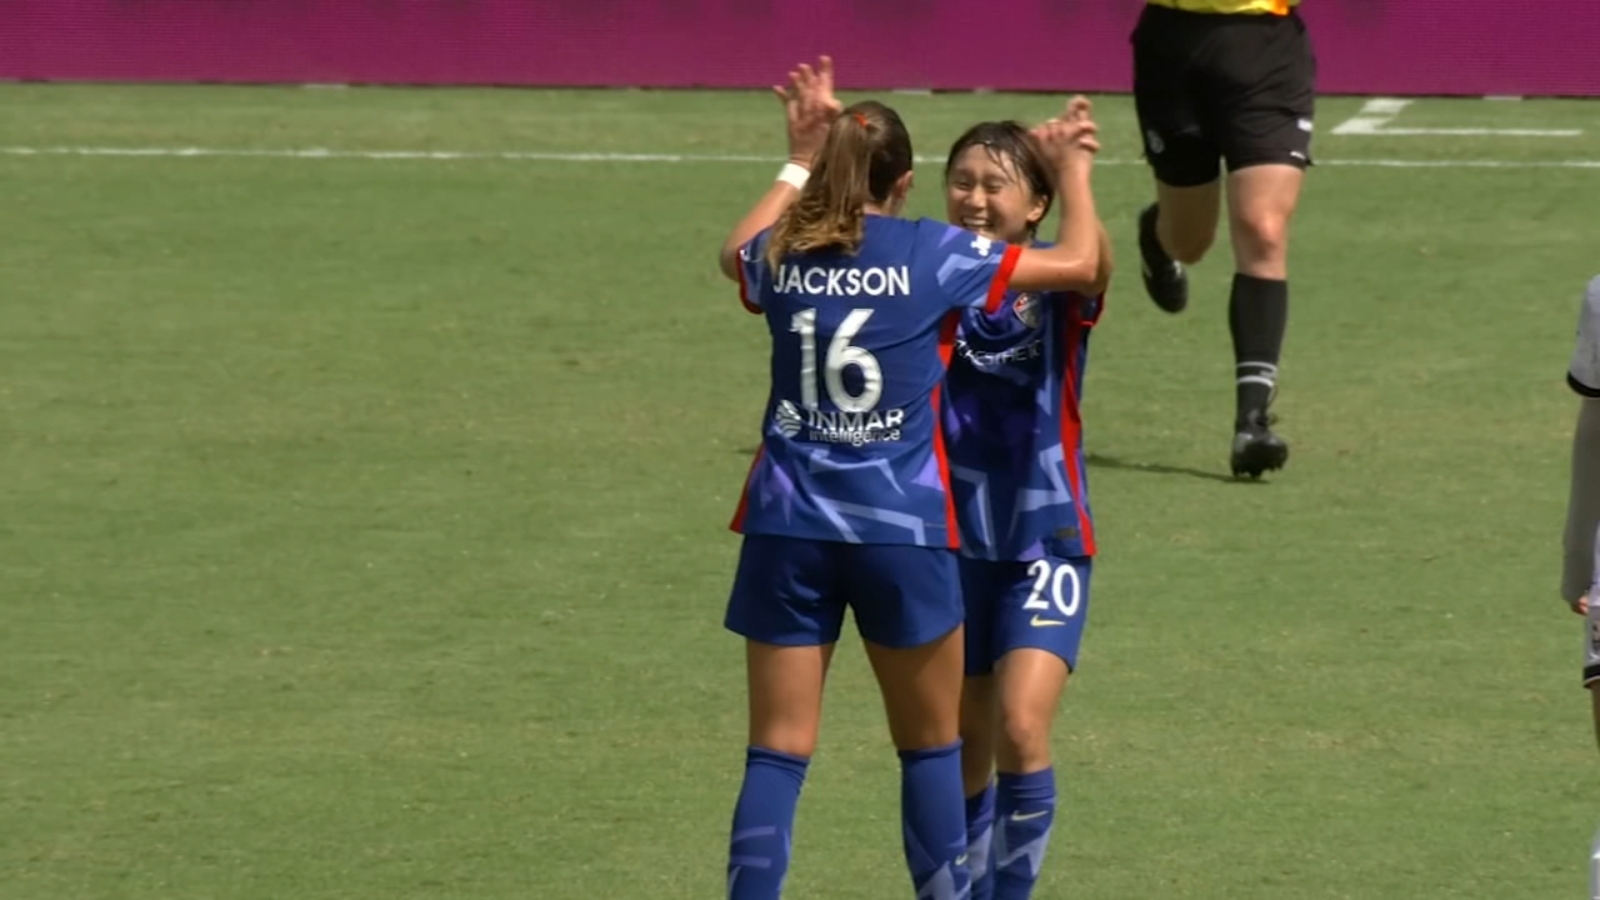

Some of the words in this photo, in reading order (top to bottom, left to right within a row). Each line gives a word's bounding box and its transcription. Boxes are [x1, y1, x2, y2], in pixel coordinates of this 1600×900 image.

[773, 264, 910, 296] JACKSON
[789, 308, 883, 413] 16
[808, 408, 904, 432] INMAR
[1022, 559, 1080, 616] 20
